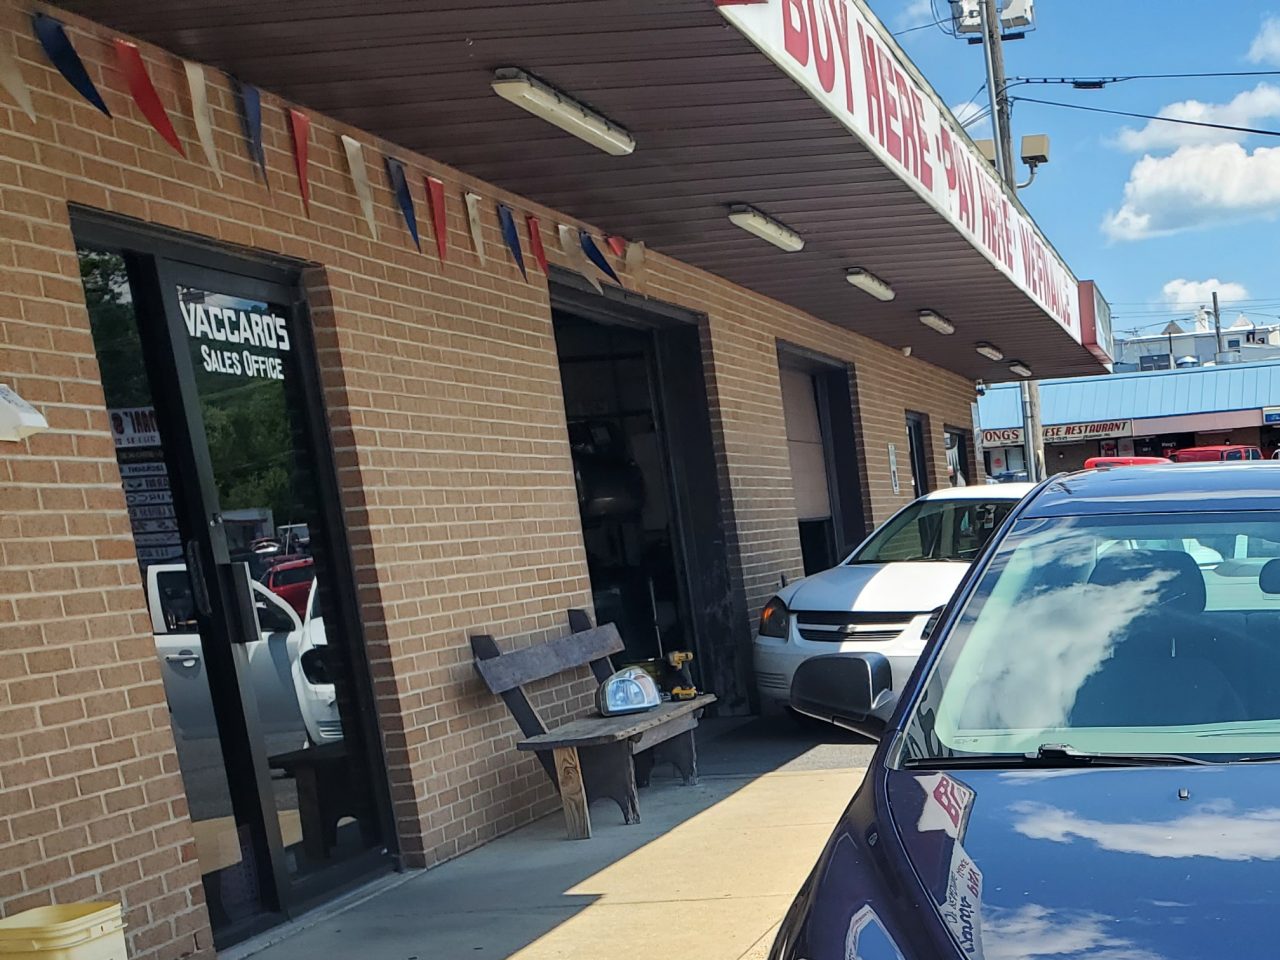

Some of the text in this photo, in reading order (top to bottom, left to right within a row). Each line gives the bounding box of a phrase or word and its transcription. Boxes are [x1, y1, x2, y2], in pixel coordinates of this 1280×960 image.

[857, 18, 933, 192] HERE
[940, 125, 976, 234] PAY
[975, 165, 1013, 272] HERE
[179, 301, 290, 351] VACCARO'S
[200, 344, 284, 380] SALES OFFICE
[1065, 421, 1128, 436] RESTAURANT
